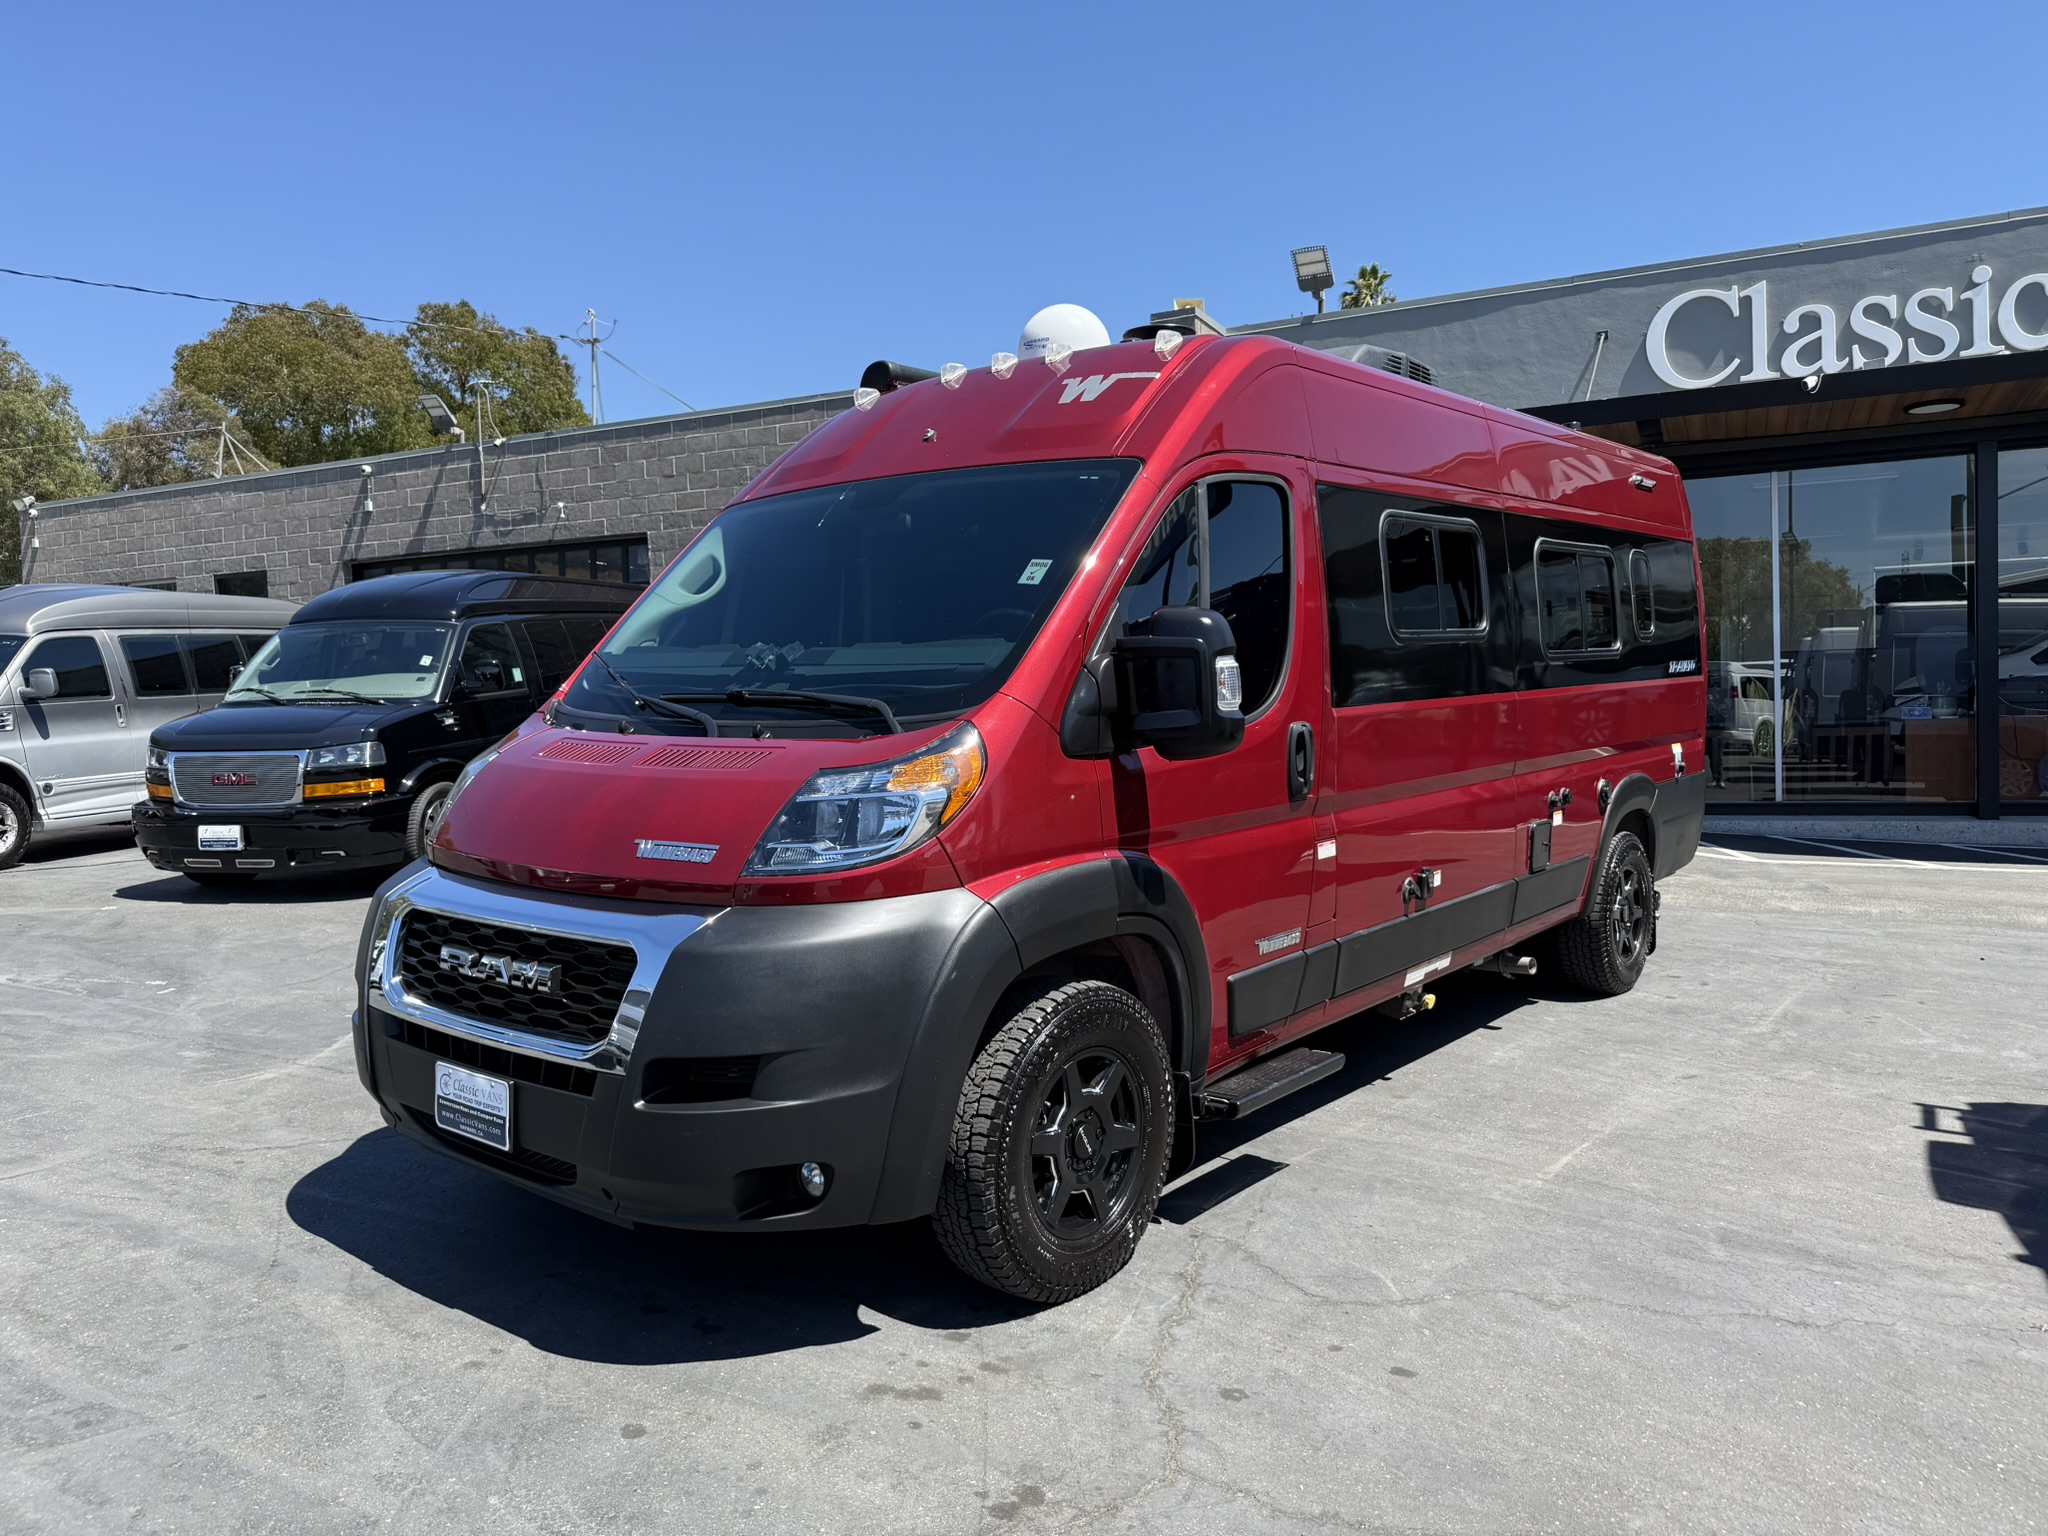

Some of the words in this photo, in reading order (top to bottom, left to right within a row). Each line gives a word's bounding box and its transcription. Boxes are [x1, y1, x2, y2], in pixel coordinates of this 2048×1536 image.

[1646, 264, 2048, 390] Classic
[213, 773, 257, 785] GMC
[634, 839, 720, 864] WINNEBAGO
[440, 943, 562, 993] RAM
[453, 1078, 479, 1098] Classic
[481, 1088, 503, 1105] VANS
[441, 1110, 502, 1135] www.ClassicVans.com
